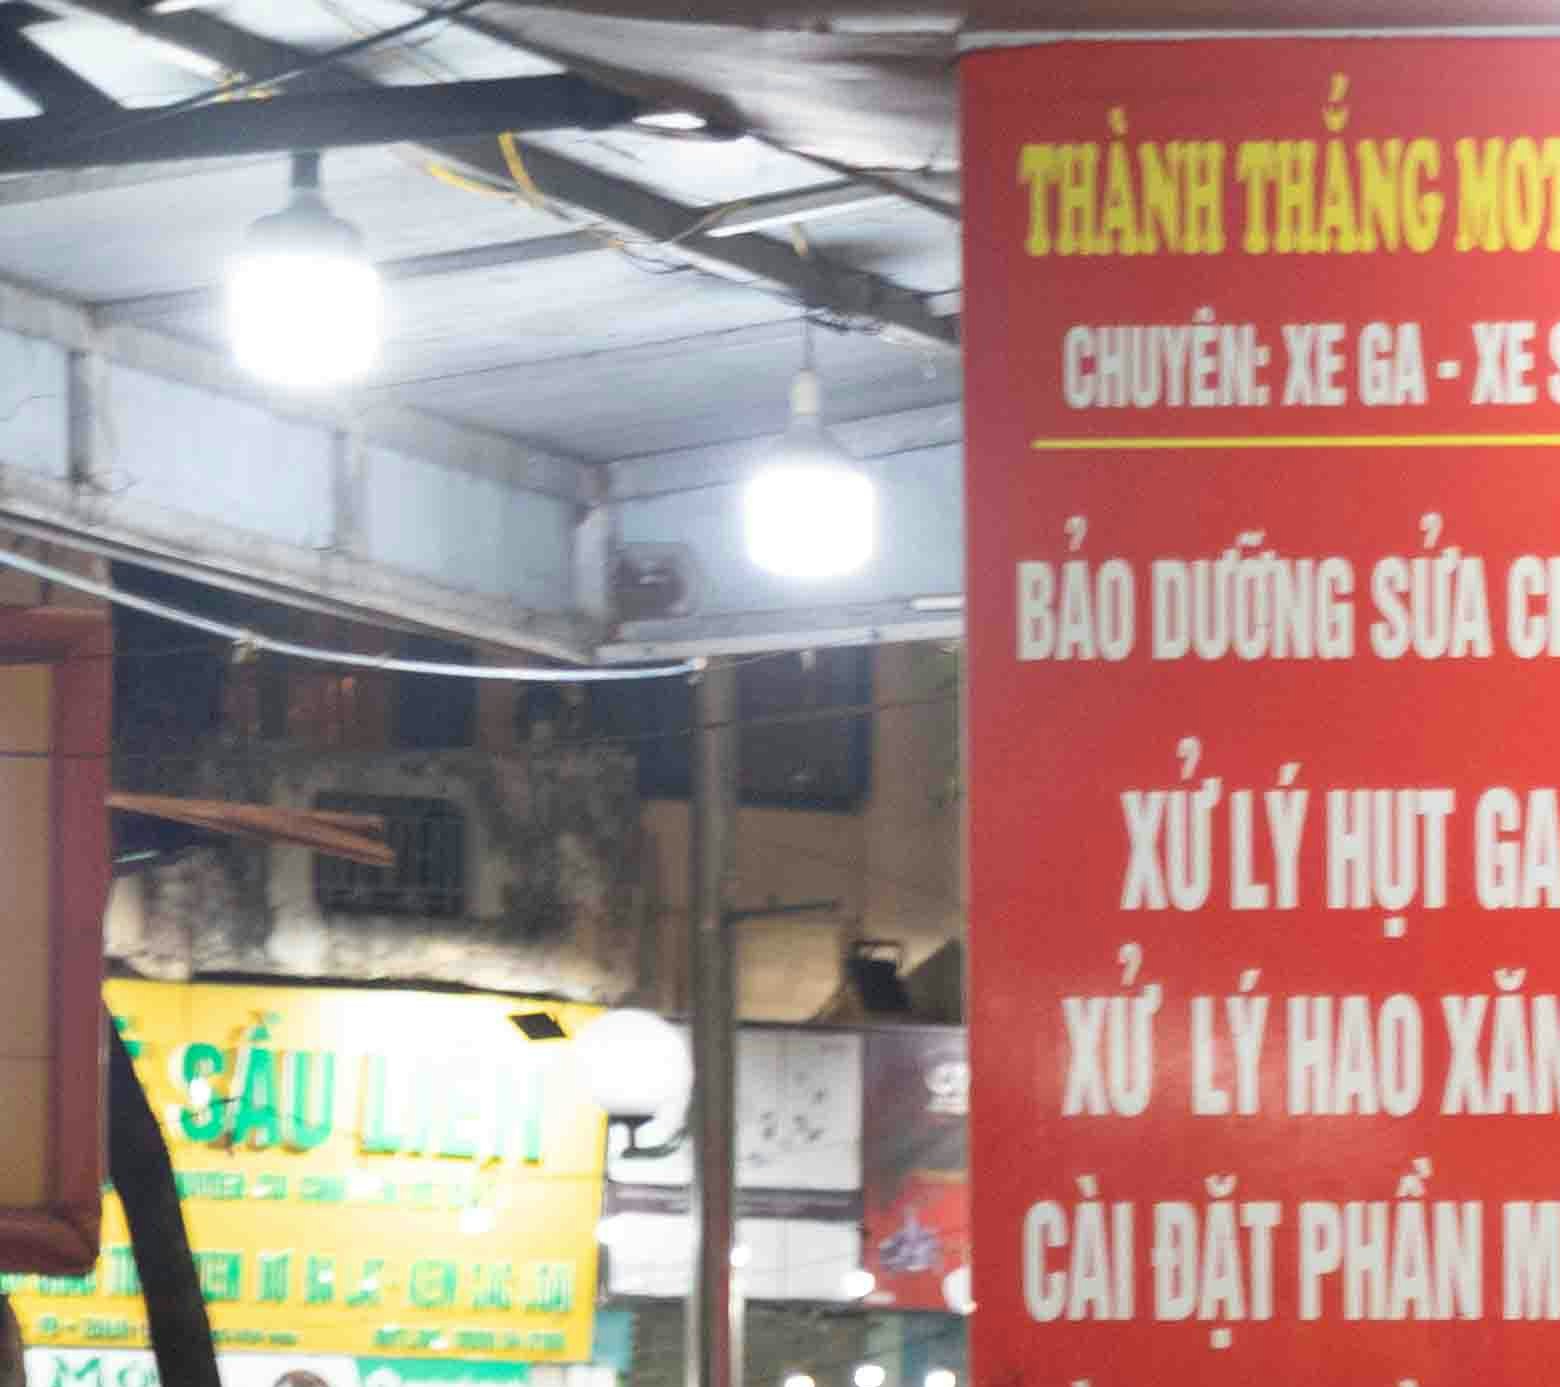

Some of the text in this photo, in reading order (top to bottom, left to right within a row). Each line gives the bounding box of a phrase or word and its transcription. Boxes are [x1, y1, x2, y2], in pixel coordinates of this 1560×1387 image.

[1020, 108, 1227, 257] THÀNH
[1237, 74, 1445, 254] THẮNG
[1063, 306, 1271, 409] CHUYÊN:
[1282, 322, 1347, 406] XE
[1359, 322, 1427, 406] GA
[1471, 320, 1537, 405] XE
[1016, 516, 1135, 662] BẢO
[1151, 531, 1355, 661] DƯỠNG
[1370, 511, 1493, 660] SỬA
[1119, 735, 1222, 912] XỬ
[1230, 762, 1309, 910] LÝ
[1326, 788, 1456, 938] HỤT
[1062, 943, 1162, 1117] XỬ
[1191, 969, 1269, 1115] LÝ
[1287, 993, 1422, 1117] HAO
[1023, 1175, 1134, 1322] CÀI
[1151, 1175, 1282, 1349] ĐẶT
[1298, 1157, 1483, 1321] PHẦN
